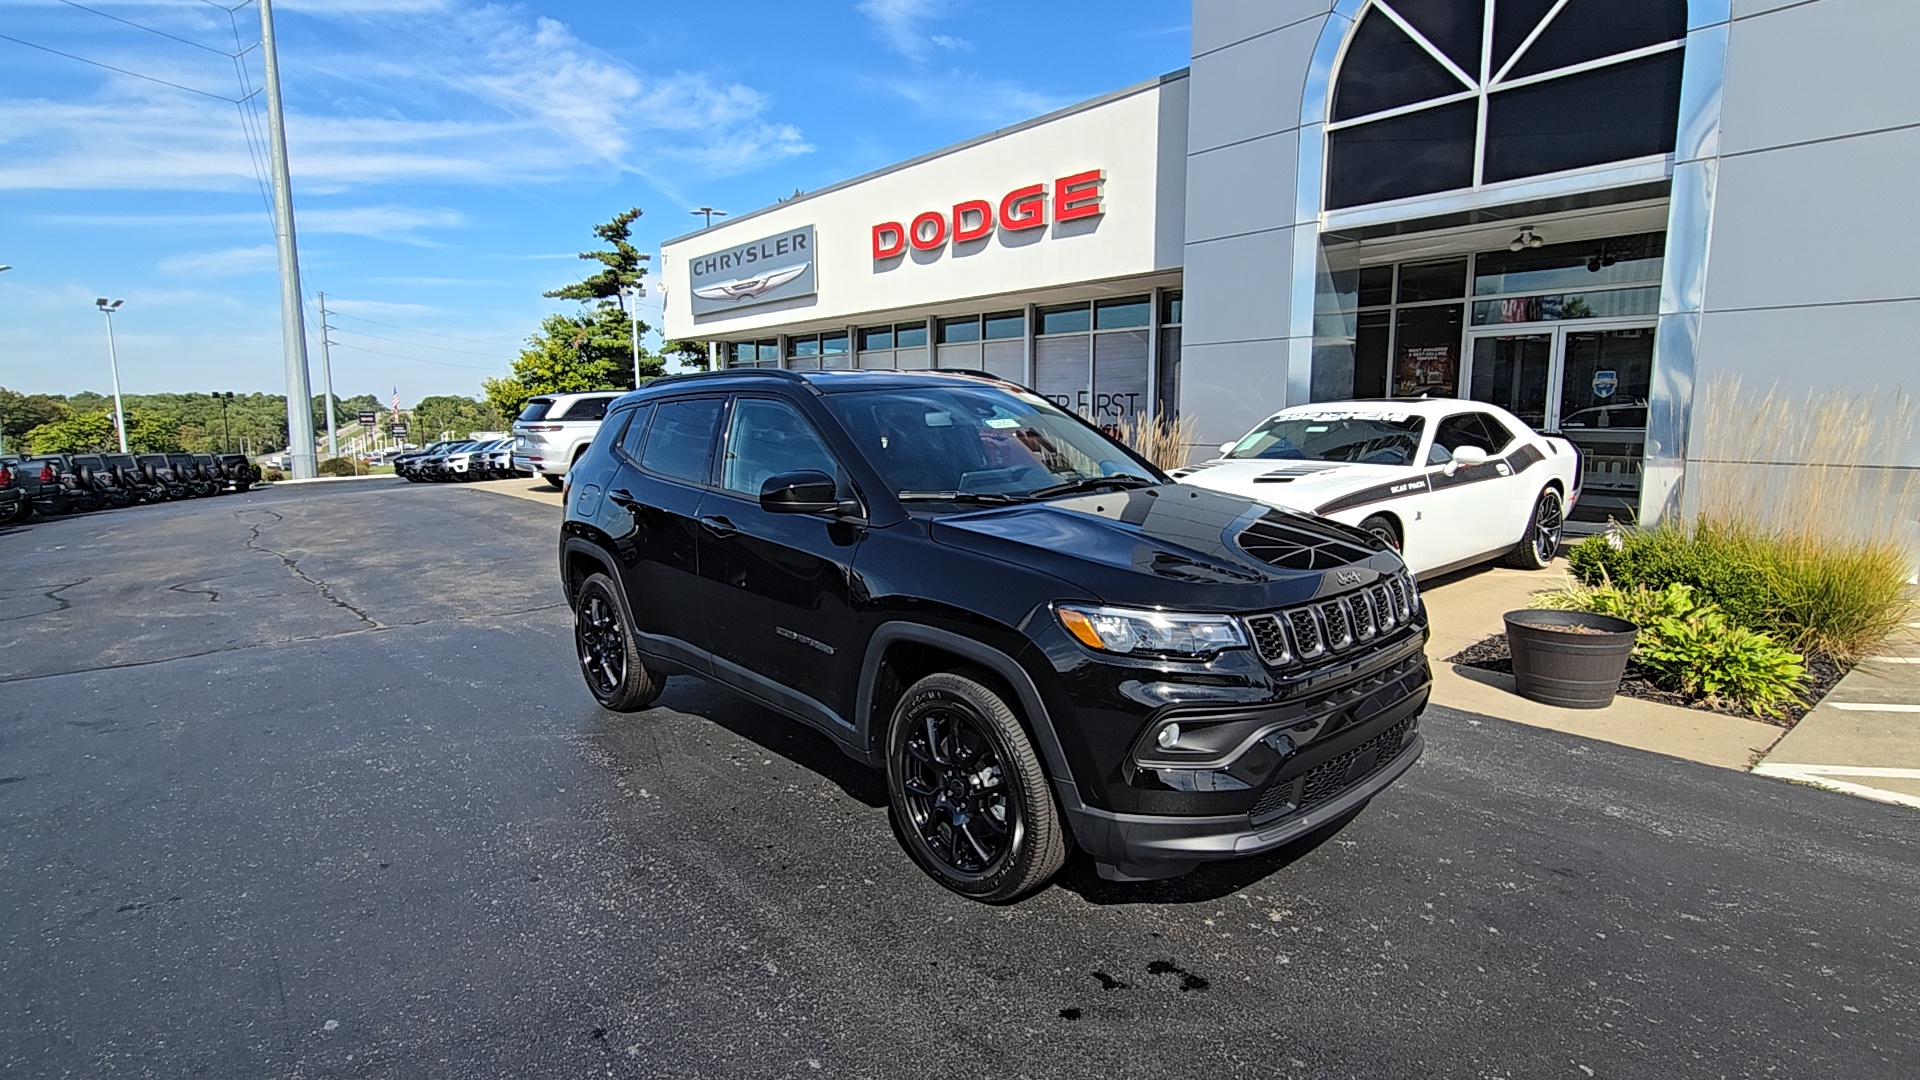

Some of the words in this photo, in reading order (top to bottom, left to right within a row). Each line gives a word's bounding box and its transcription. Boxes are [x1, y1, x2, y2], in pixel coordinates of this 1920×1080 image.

[872, 169, 1105, 260] DODGE
[693, 233, 807, 276] CHRYSLER
[1077, 390, 1140, 417] FIRST
